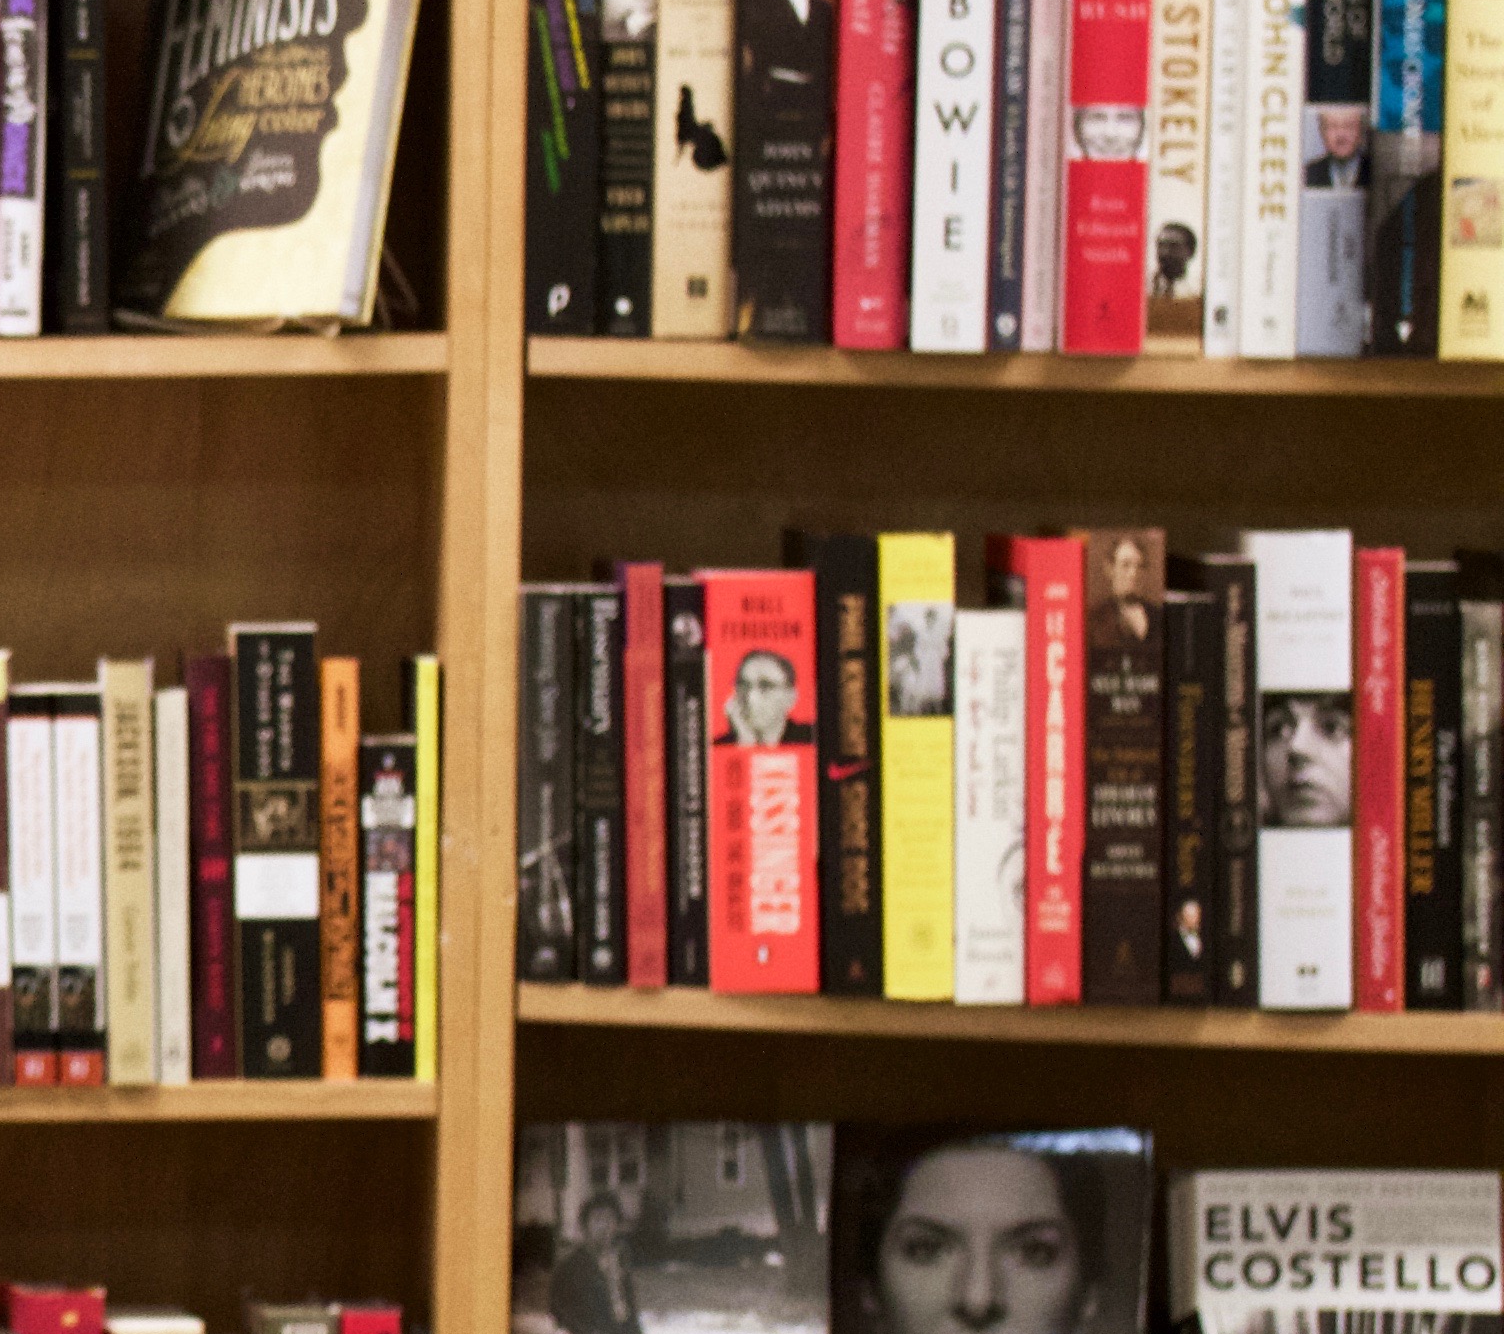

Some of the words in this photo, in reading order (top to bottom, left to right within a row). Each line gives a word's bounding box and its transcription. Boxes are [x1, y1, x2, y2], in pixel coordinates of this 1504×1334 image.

[1163, 2, 1200, 189] STOKELY
[1257, 84, 1287, 222] CLEESE
[720, 617, 806, 642] FERGUSON
[840, 656, 867, 758] KNIGHT
[988, 646, 1016, 725] Philip
[1411, 678, 1433, 781] HENRY
[989, 733, 1016, 822] Larkin
[748, 752, 801, 935] KISSINGER
[1411, 789, 1433, 895] MILLER
[1201, 1250, 1497, 1293] COSTELLO
[1204, 1203, 1355, 1244] ELVIS
